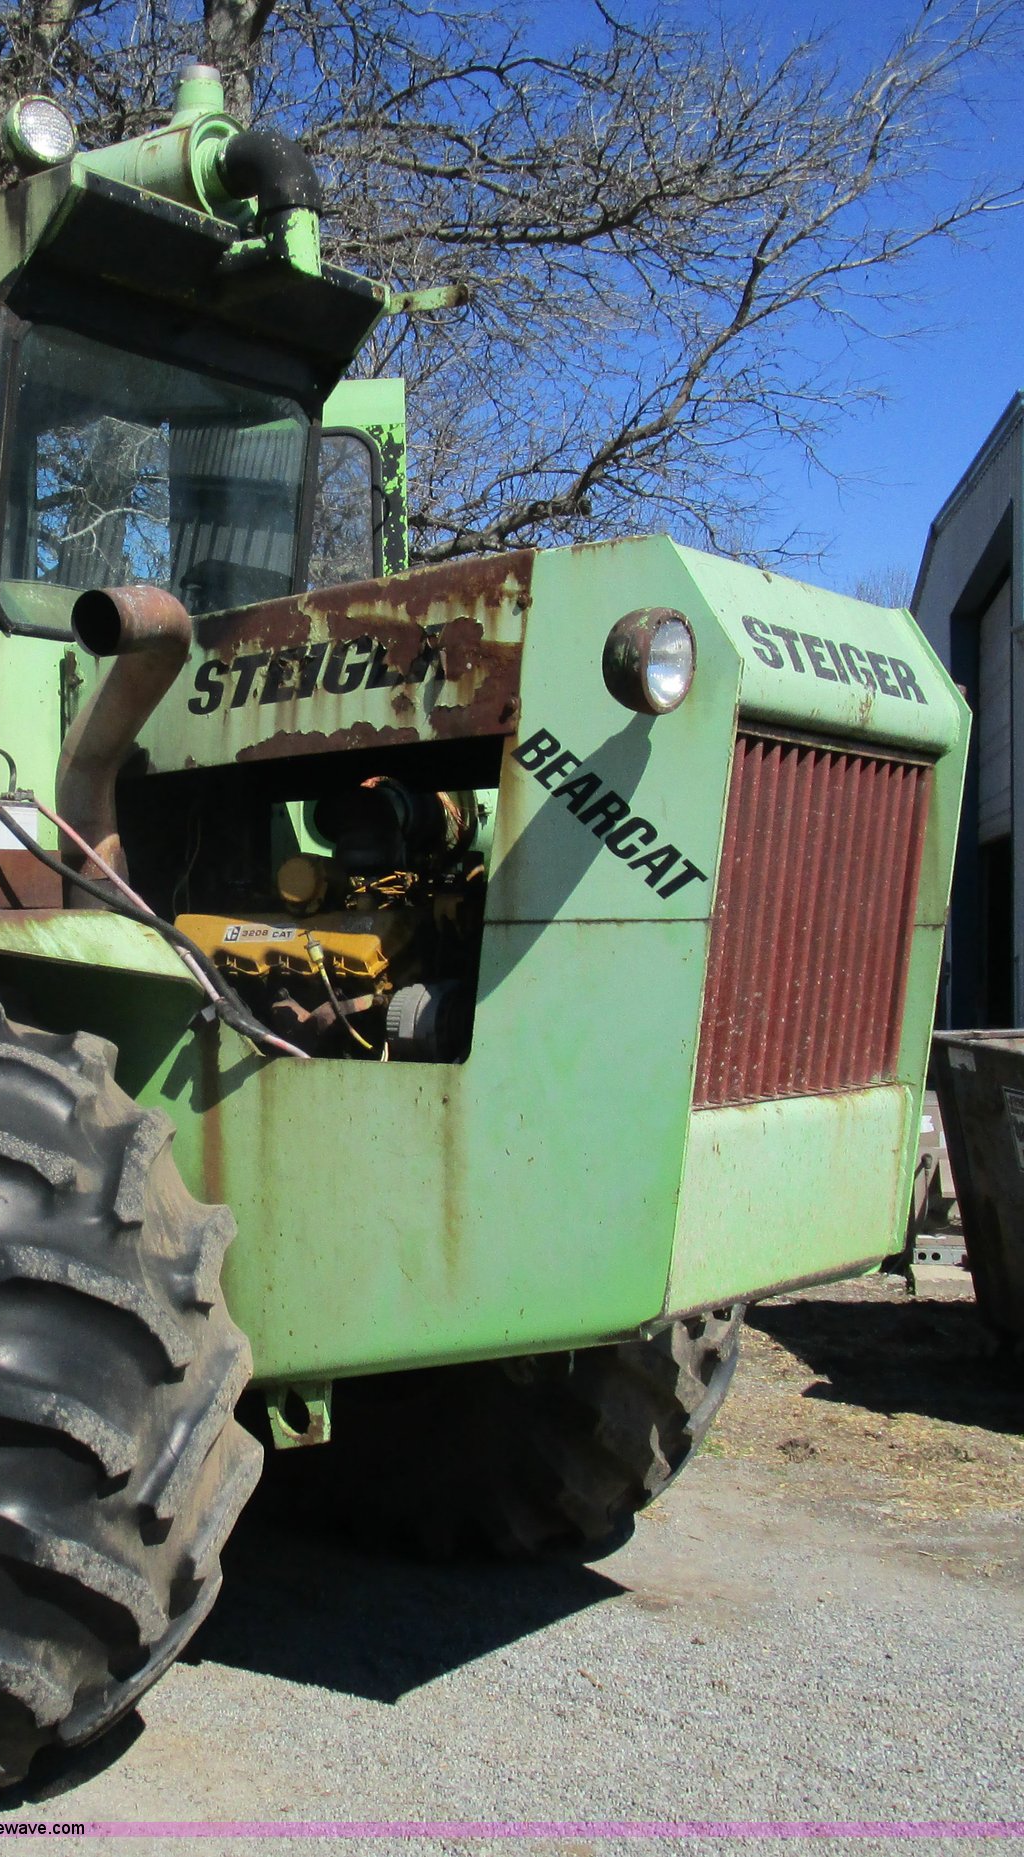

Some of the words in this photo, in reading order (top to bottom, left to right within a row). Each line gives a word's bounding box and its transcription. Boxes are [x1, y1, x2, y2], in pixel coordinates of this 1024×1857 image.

[741, 614, 929, 705] STEIGER
[510, 727, 709, 900] BEARCAT
[241, 929, 269, 937] 3208
